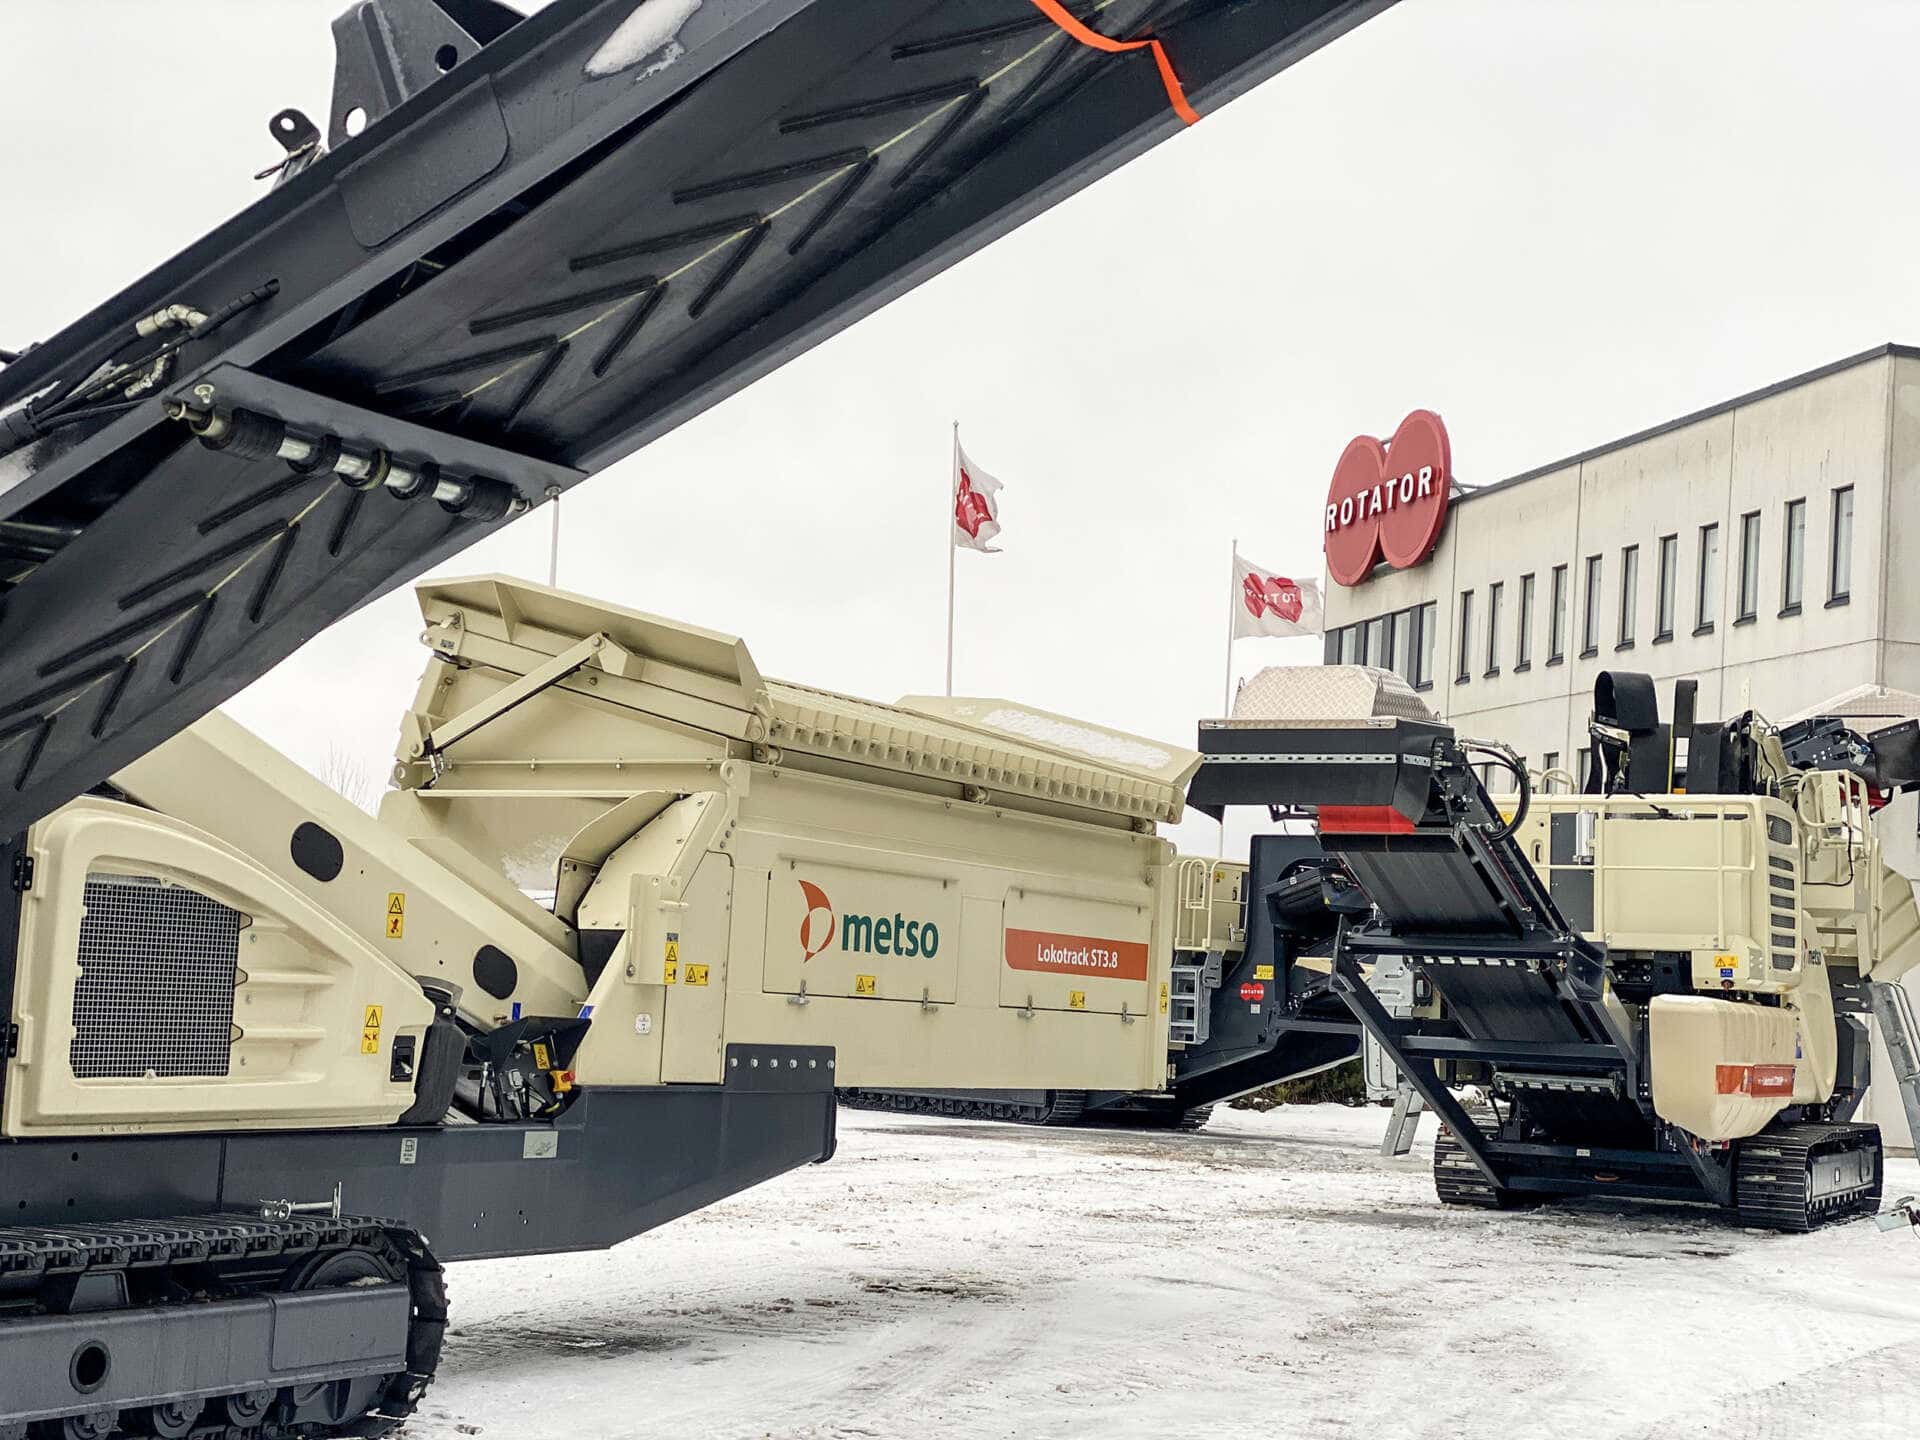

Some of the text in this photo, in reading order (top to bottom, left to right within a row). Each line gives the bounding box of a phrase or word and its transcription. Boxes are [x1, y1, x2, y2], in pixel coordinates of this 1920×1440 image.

[1325, 465, 1432, 532] ROTATOR
[841, 912, 939, 959] metso
[1037, 943, 1118, 968] Lokotrack ST3.8
